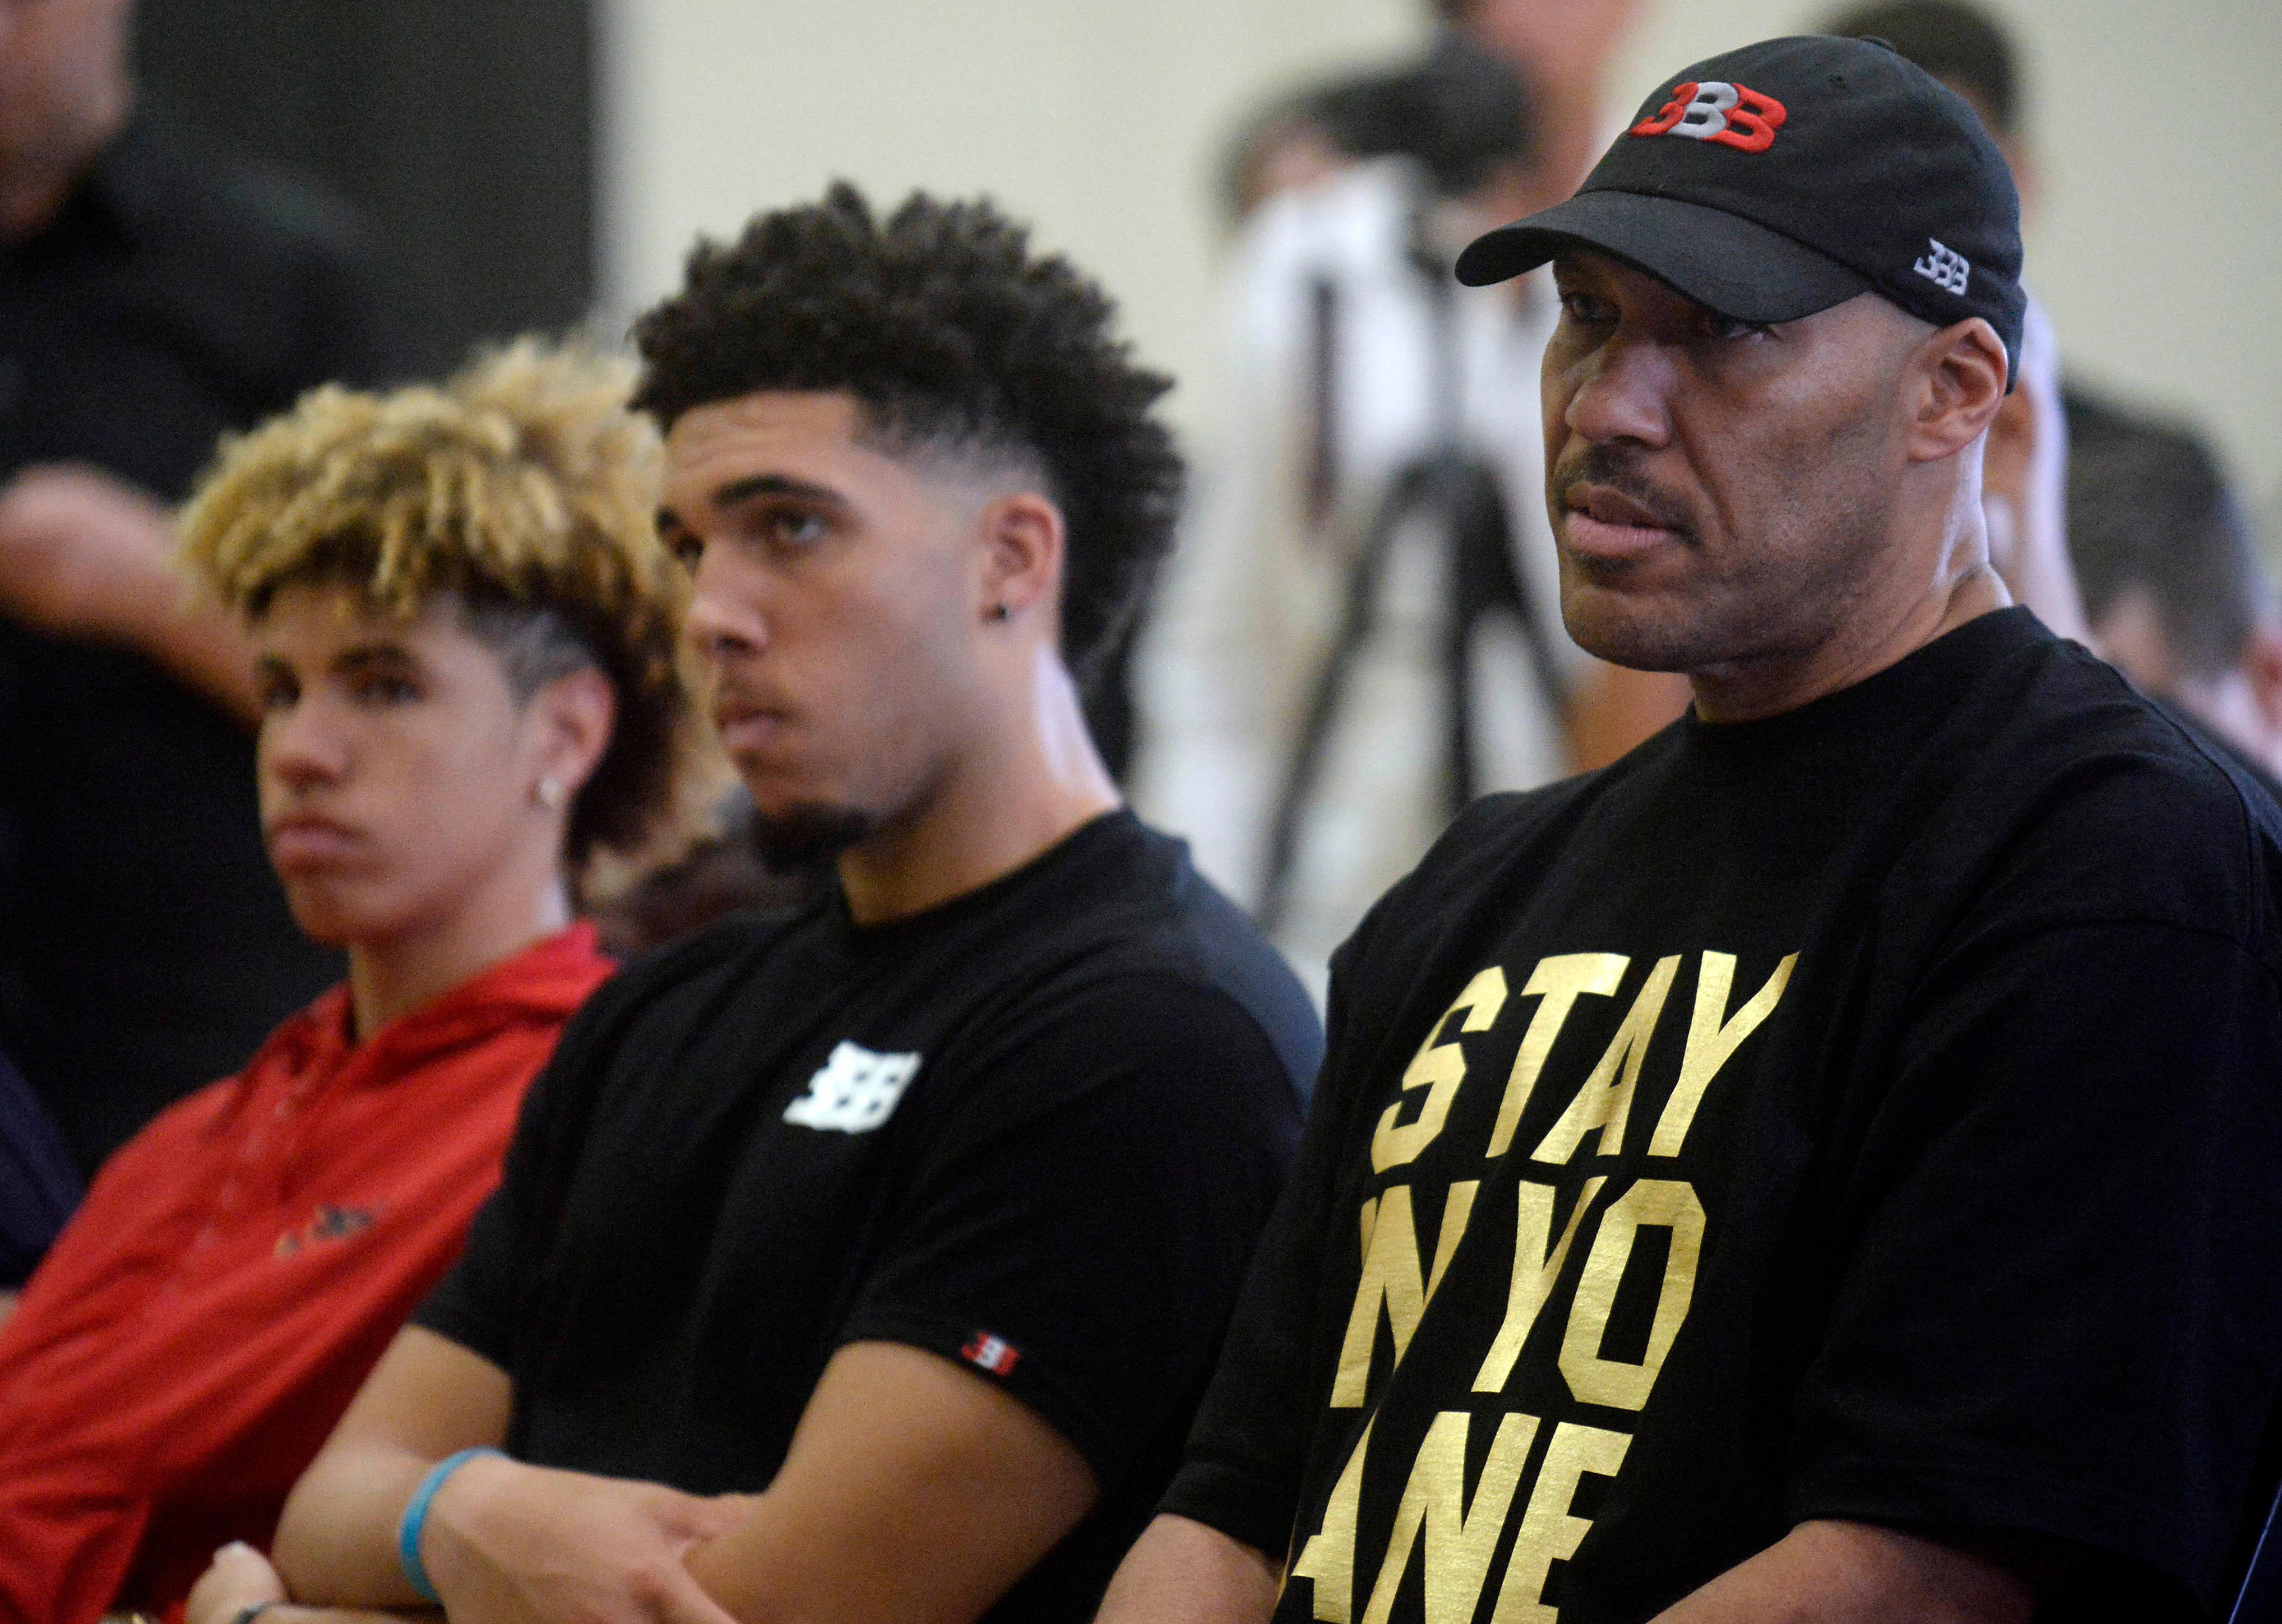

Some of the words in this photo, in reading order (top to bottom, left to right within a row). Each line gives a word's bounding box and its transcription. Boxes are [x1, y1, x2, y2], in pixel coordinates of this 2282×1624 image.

[1371, 950, 1799, 1174] STAY
[1330, 1179, 1480, 1408] N
[1471, 1176, 1706, 1411] YO
[1281, 1407, 1634, 1624] ANE
